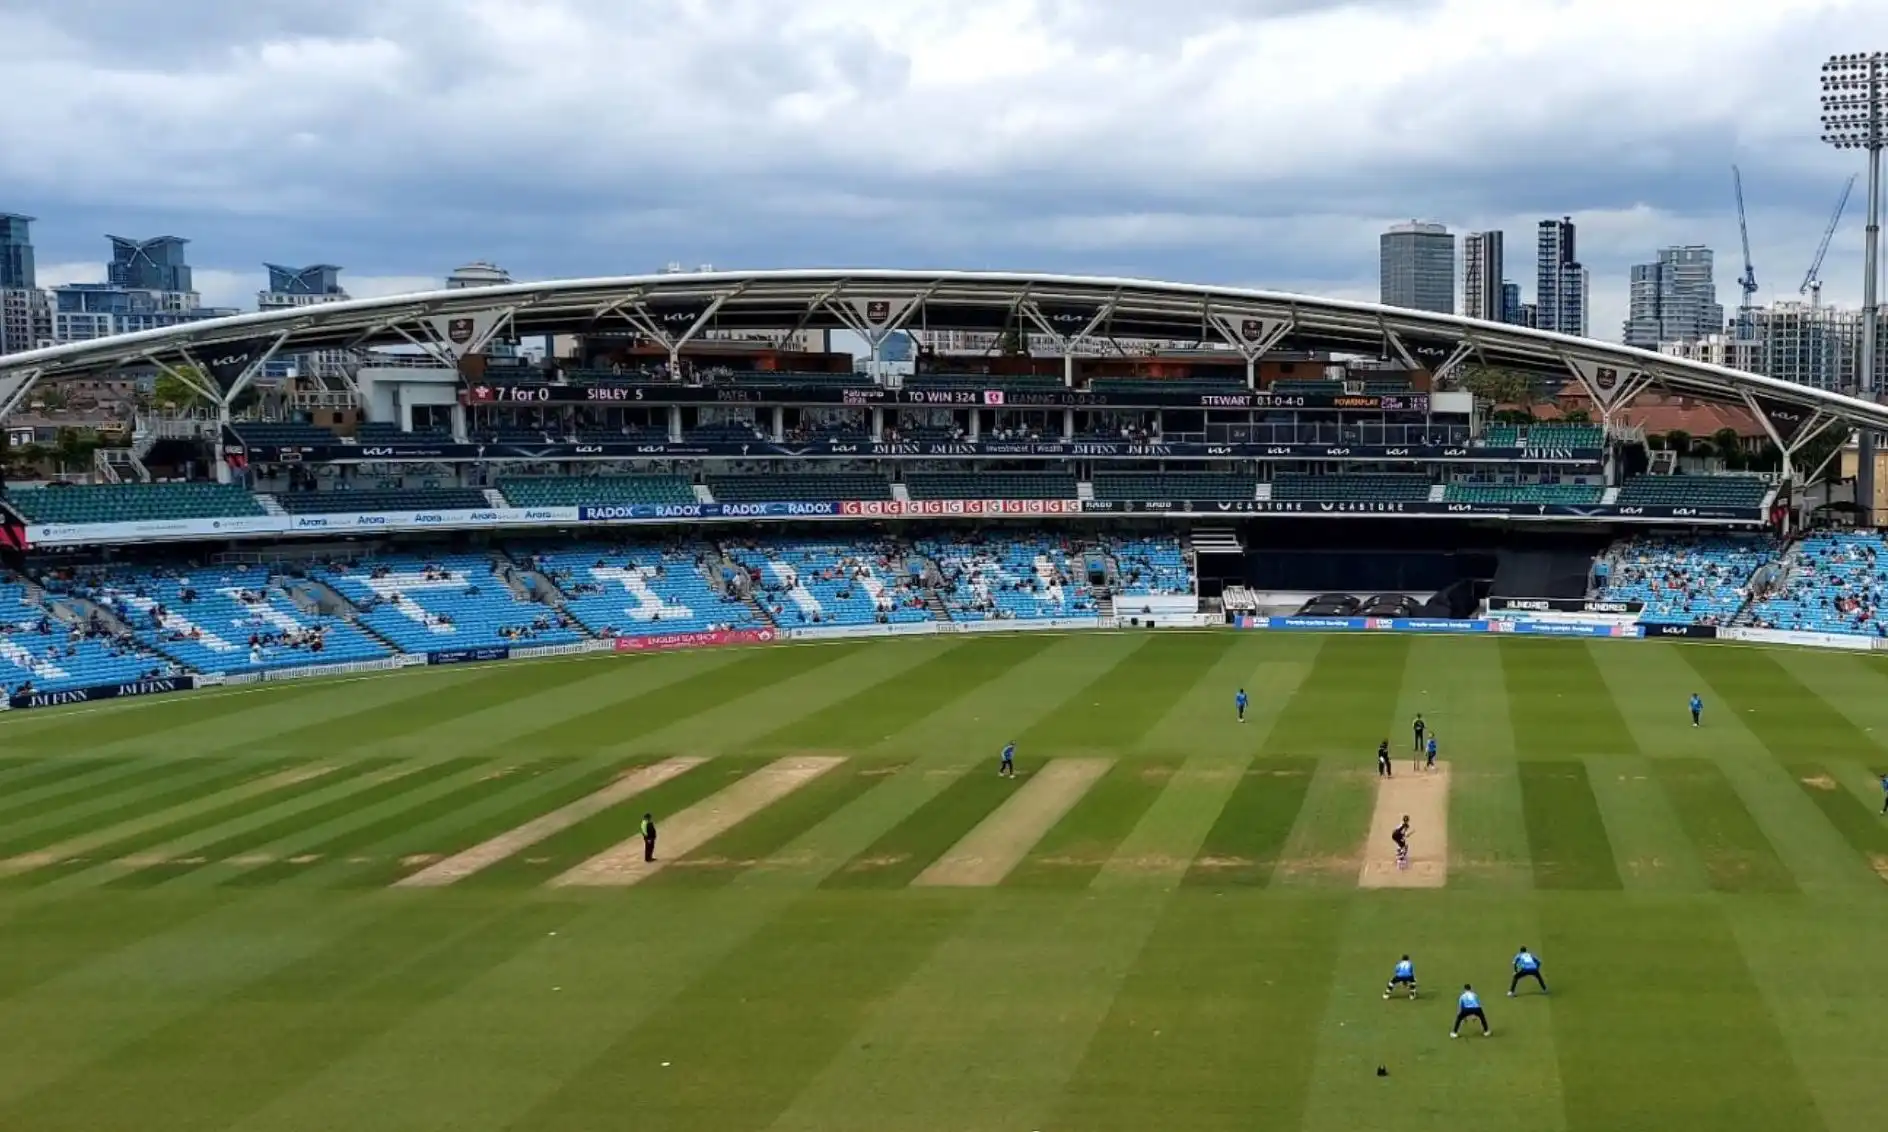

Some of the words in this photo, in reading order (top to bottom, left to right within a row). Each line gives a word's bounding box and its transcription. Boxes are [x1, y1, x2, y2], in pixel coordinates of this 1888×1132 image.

[495, 387, 505, 400] 7
[511, 387, 534, 400] for
[539, 387, 549, 401] 0
[588, 388, 628, 400] SIBLEY
[636, 388, 643, 400] 5
[908, 391, 924, 402] TO
[927, 391, 952, 402] WIN
[956, 392, 976, 403] 324
[1201, 395, 1252, 406] STEWART
[1521, 448, 1538, 459] JM
[1542, 448, 1573, 459] FINN
[587, 506, 633, 519] RADOX
[655, 505, 701, 517] RADOX
[722, 504, 768, 515] RADOX
[787, 502, 832, 514] RADOX
[1236, 502, 1302, 511] CASTORE
[1338, 502, 1404, 511] CASTORE
[1507, 600, 1549, 609] HUNDRED
[1584, 602, 1628, 611] HUNDRED
[117, 683, 137, 696] JM
[140, 679, 176, 694] FINN
[28, 694, 49, 707] JM
[52, 689, 88, 705] FINN
